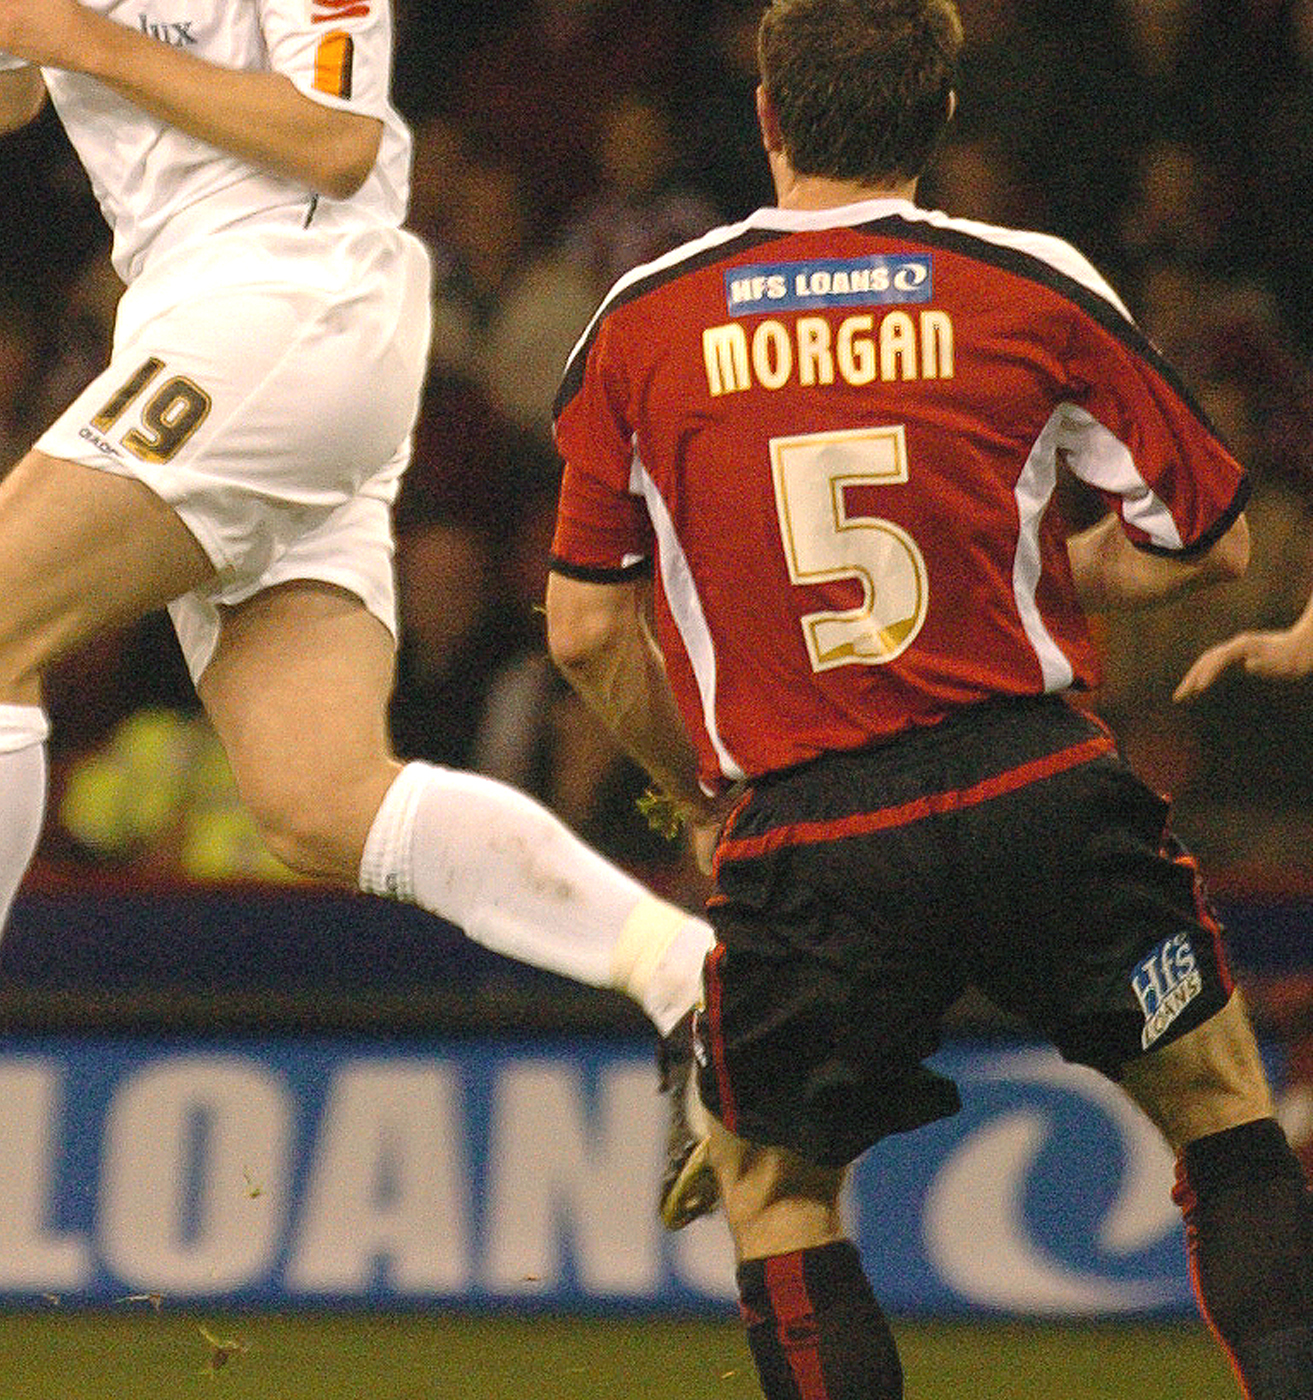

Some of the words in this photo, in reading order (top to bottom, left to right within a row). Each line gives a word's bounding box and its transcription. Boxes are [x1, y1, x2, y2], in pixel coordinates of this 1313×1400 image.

[730, 275, 787, 303] HFS
[795, 267, 890, 297] LOANS
[702, 310, 954, 397] MORGAN
[90, 357, 212, 464] 19
[769, 425, 929, 673] 5
